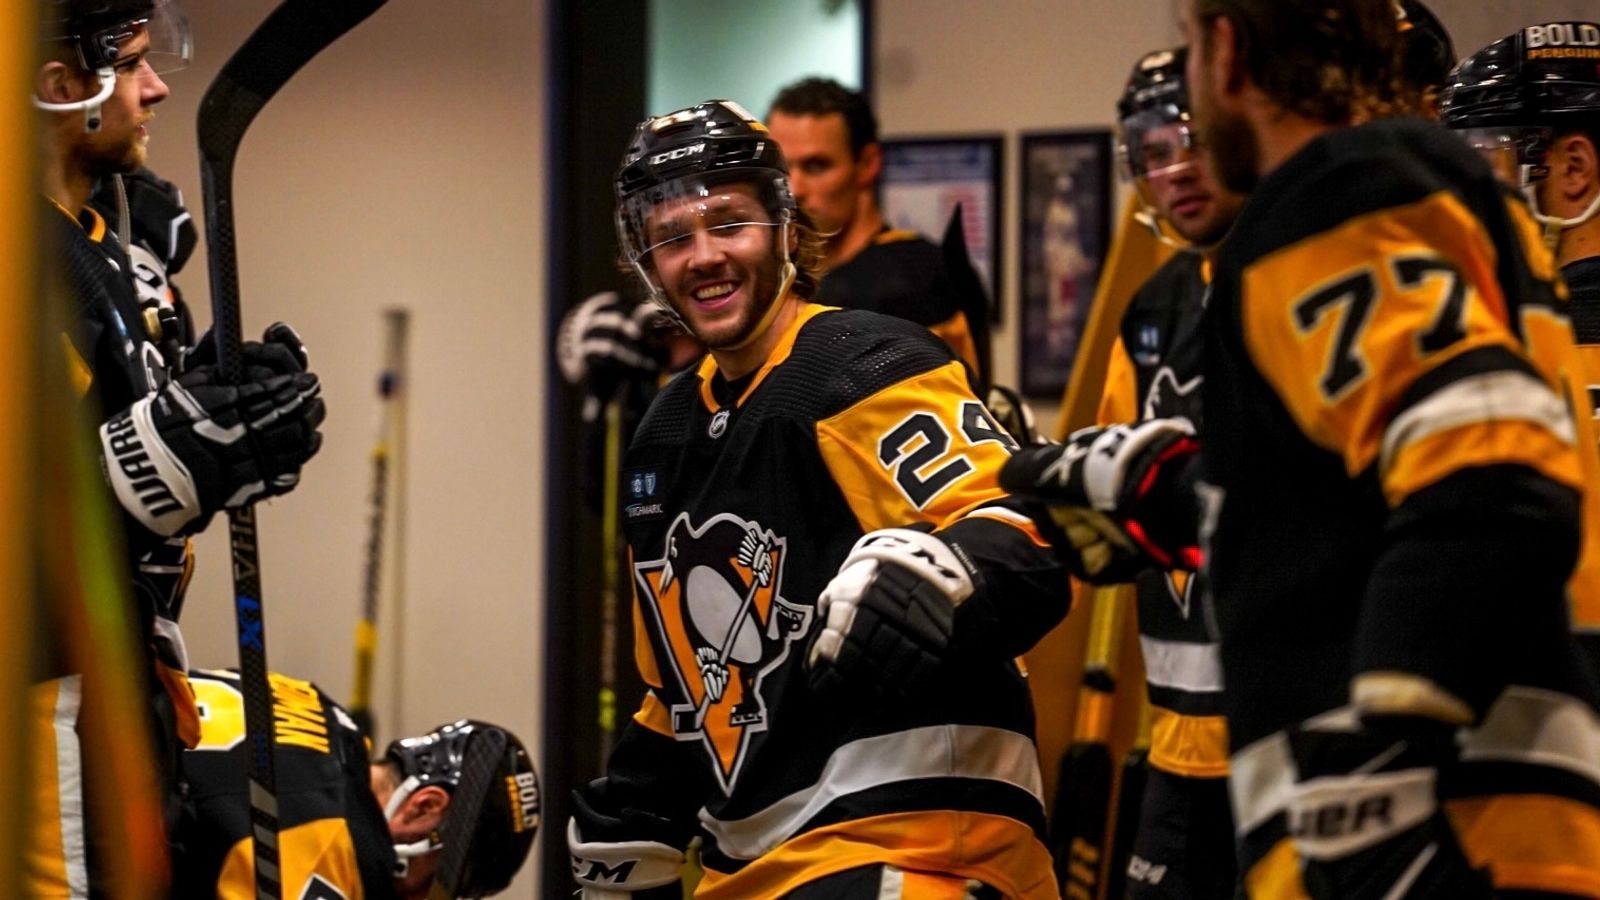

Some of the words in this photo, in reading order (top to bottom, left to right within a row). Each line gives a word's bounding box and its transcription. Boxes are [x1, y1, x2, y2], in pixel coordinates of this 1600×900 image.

[1525, 23, 1600, 49] BOLD
[651, 143, 706, 165] CCM
[1291, 254, 1470, 405] 77
[877, 401, 1020, 511] 24
